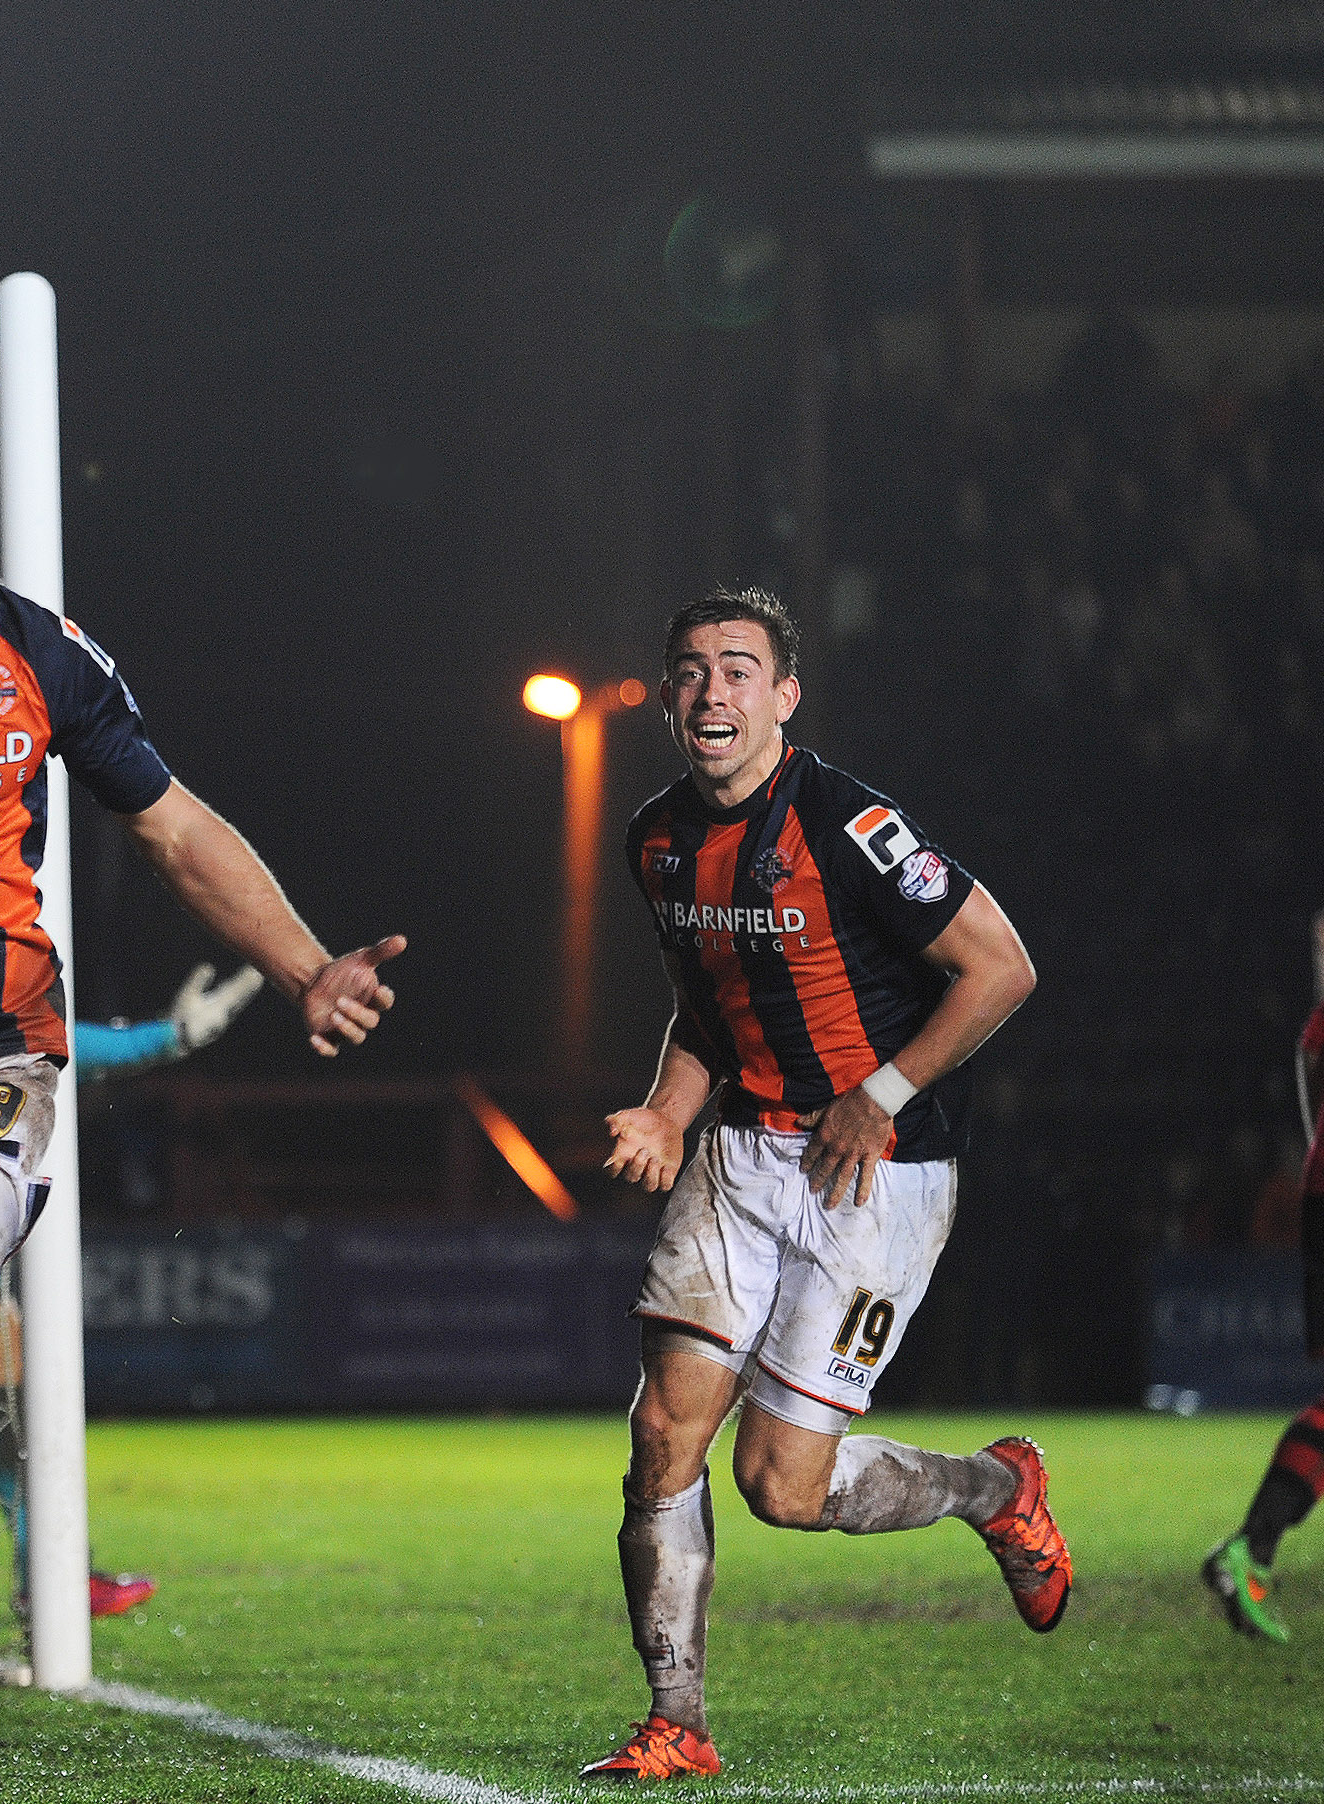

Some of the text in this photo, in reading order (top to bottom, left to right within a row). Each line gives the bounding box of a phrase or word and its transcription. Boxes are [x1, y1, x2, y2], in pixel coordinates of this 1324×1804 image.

[673, 901, 807, 934] BARNFIELD
[675, 932, 811, 954] COLLEGE
[829, 1285, 895, 1368] 19
[832, 1362, 866, 1386] FILA
